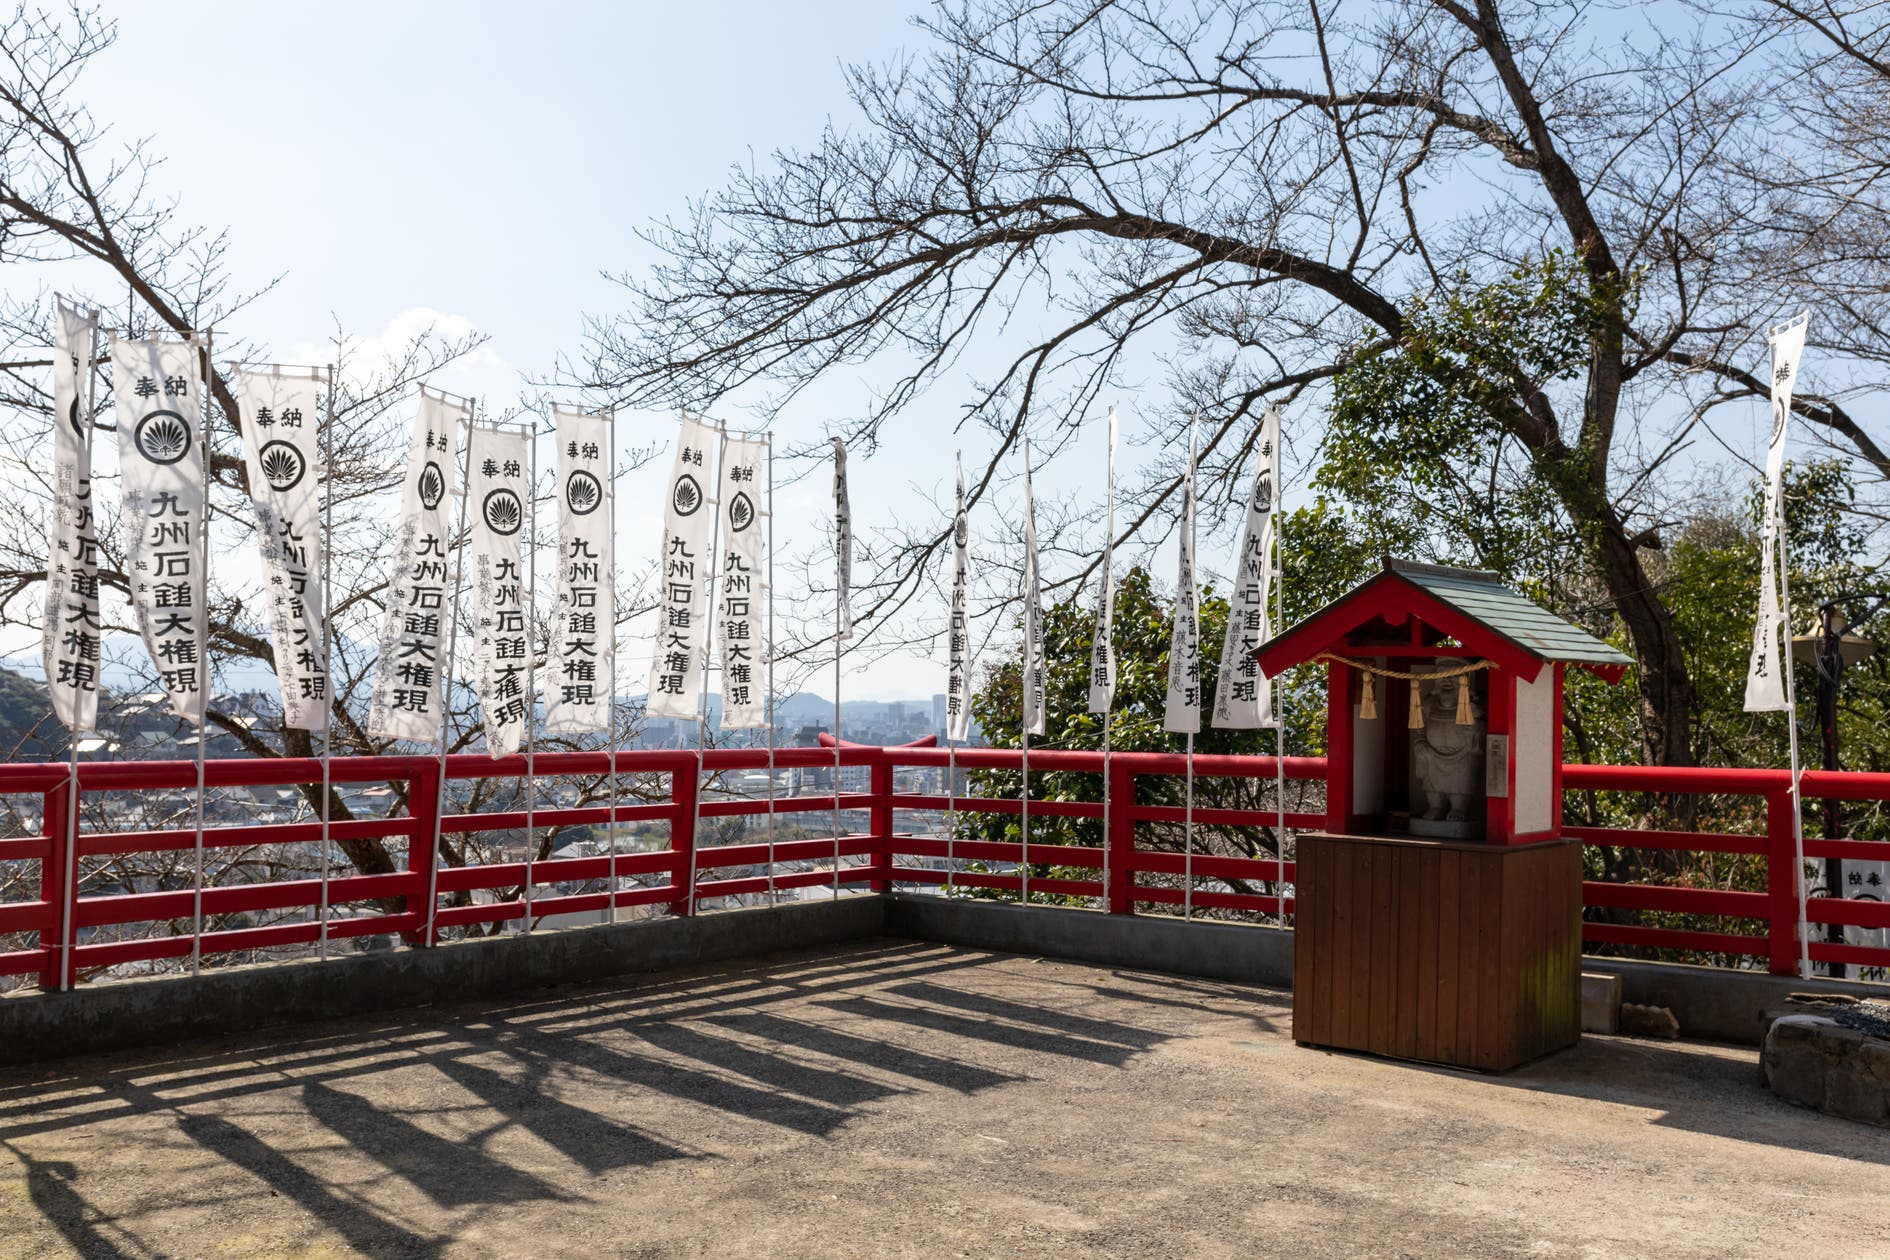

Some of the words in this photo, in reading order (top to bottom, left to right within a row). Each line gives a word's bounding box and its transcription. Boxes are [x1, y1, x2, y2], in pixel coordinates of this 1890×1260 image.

[134, 376, 188, 399] 奉納
[256, 406, 303, 428] 奉納
[425, 429, 448, 453] 奉納
[566, 440, 599, 460] 奉納
[482, 458, 521, 479] 奉納
[681, 446, 703, 467] 奉納
[730, 465, 753, 483] 奉納
[56, 539, 70, 575] 施主
[136, 560, 149, 593] 施主
[271, 575, 286, 606] 施主
[150, 491, 199, 694] 九州石鎚大権現
[391, 589, 406, 619] 施主
[558, 593, 569, 621] 施主
[1235, 591, 1246, 618] 施主
[391, 533, 448, 714] 九州石鎚大権現
[560, 537, 599, 706] 九州石鎚大権現
[657, 536, 695, 694] 九州石鎚大権現
[725, 552, 752, 706] 九州石鎚大権現
[1182, 545, 1200, 707] 州石鎚大権現
[1232, 533, 1263, 702] 九州石鎚大権現
[480, 617, 493, 646] 施主
[493, 558, 527, 729] 九州石鎚大権現
